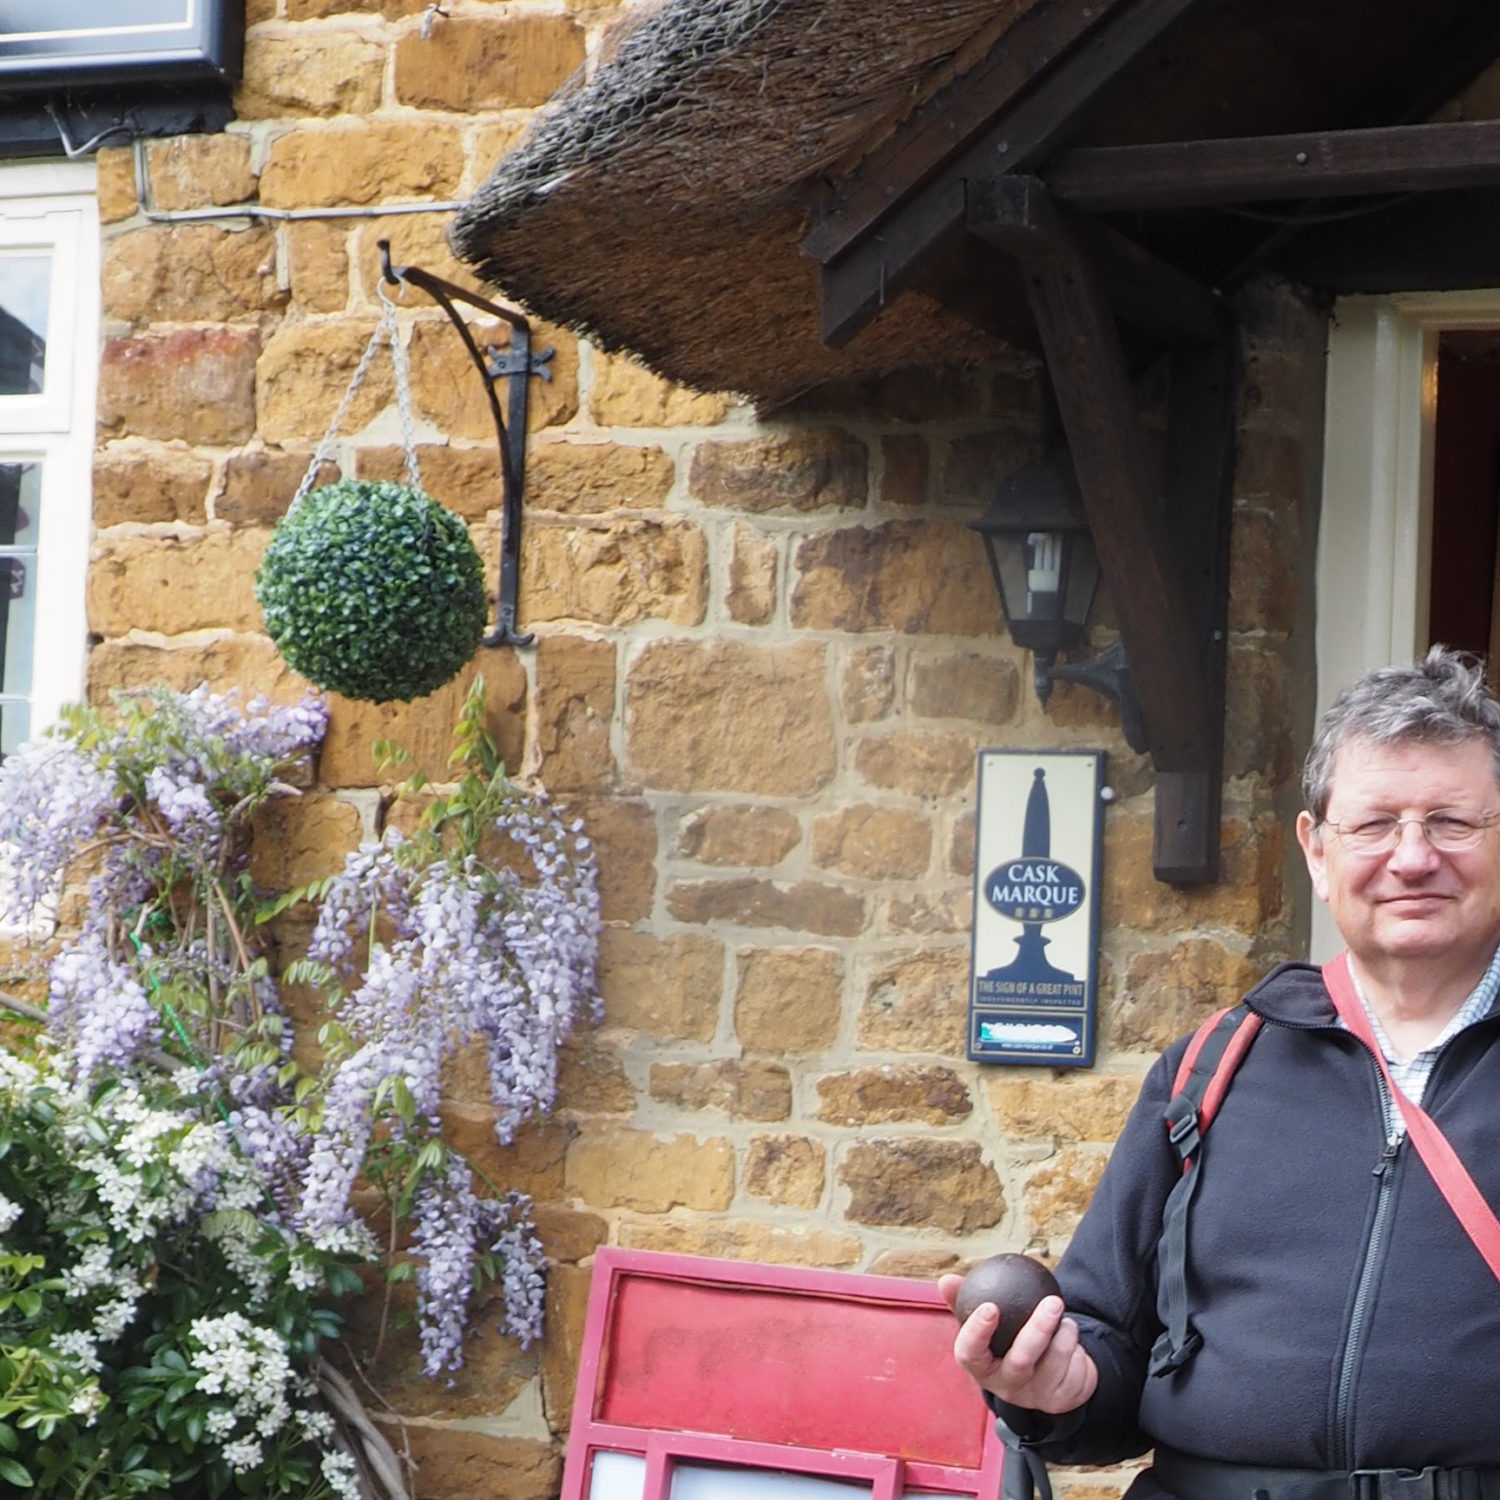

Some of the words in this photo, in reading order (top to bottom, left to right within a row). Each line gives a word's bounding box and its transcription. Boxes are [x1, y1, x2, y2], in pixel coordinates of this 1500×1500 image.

[1008, 864, 1060, 883] CASK
[992, 885, 1079, 906] MARQUE
[979, 981, 994, 993] THE
[1016, 982, 1028, 994] OF
[1036, 983, 1062, 995] GREAT
